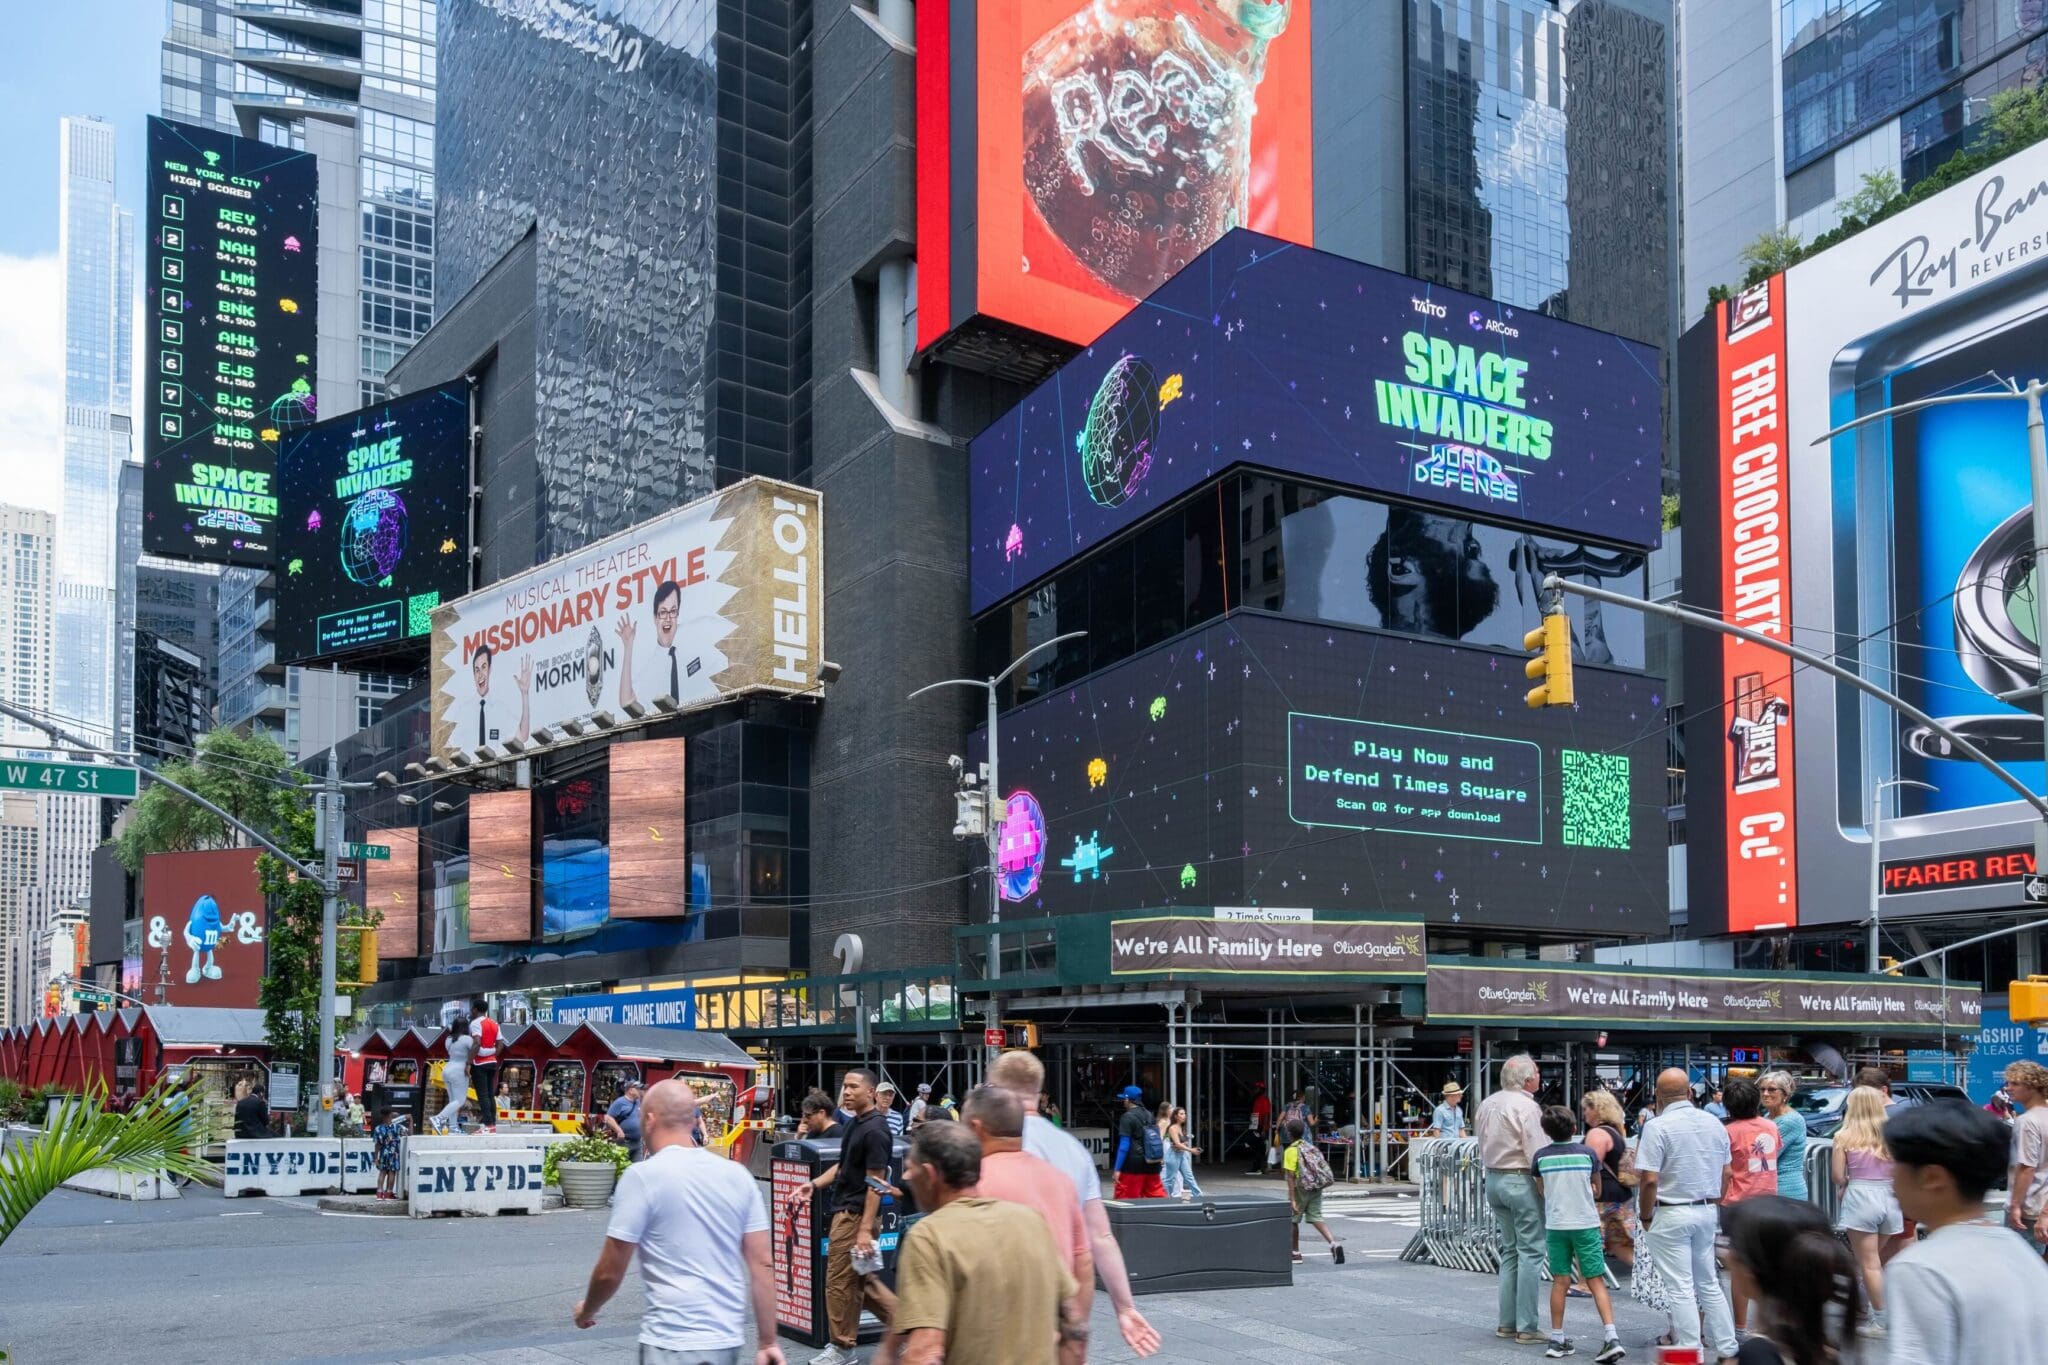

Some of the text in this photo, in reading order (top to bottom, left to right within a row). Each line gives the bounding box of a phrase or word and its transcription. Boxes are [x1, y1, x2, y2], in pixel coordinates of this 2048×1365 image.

[165, 161, 261, 189] NEW YORK CITY
[170, 174, 252, 199] HIGH SCORES
[168, 203, 179, 215] 1
[219, 208, 256, 226] REY
[167, 233, 179, 245] 2
[219, 239, 256, 257] NAH
[1971, 232, 2048, 279] REVERS
[166, 264, 179, 276] 3
[220, 269, 256, 287] LMM
[166, 296, 178, 307] 4
[218, 300, 255, 318] BNK
[1412, 298, 1447, 318] TAITO
[165, 326, 178, 338] 5
[1485, 319, 1519, 338] ARCore
[218, 331, 255, 348] AHH
[165, 358, 178, 370] 6
[218, 361, 255, 379] EJS
[1402, 331, 1529, 409] SPACE
[165, 389, 177, 401] 7
[216, 392, 253, 409] BJC
[164, 420, 177, 432] 8
[1375, 379, 1554, 461] INVADERS
[216, 423, 253, 440] NHB
[347, 436, 402, 474] SPACE
[1431, 444, 1502, 475] WORLD
[192, 462, 271, 495] SPACE
[335, 459, 413, 499] INVADERS
[1415, 463, 1518, 503] DEFENSE
[351, 497, 396, 517] DEFENSE
[357, 489, 389, 505] WORLD
[1731, 353, 1781, 646] FREE CHOCOLATE
[197, 517, 262, 535] DEFENSE
[207, 509, 253, 523] WORLD
[506, 542, 653, 615] MUSICAL THEATER.
[771, 496, 808, 685] HELLO!
[372, 610, 386, 619] and
[463, 546, 710, 665] MISSIONARY STYLE.
[322, 629, 347, 640] Defend
[349, 625, 369, 635] Times
[372, 620, 397, 630] Square
[536, 646, 585, 671] THE BOOK OF
[1353, 740, 1494, 772] Play Now and
[7, 766, 99, 790] W 47 St
[1305, 765, 1527, 803] Defend Times Square
[1336, 798, 1501, 824] Scan QR for app download
[352, 845, 361, 857] W
[366, 846, 378, 857] 47
[1114, 935, 1323, 961] We're All Family Here
[1567, 987, 1709, 1011] We're All Family Here
[1800, 995, 1905, 1015] We're All Family Here
[558, 1006, 613, 1025] CHANGE MONEY
[622, 1001, 687, 1026] CHANGE MONEY
[1983, 1044, 2024, 1055] LEASE
[242, 1151, 326, 1176] NYPD
[434, 1164, 526, 1192] NYPD
